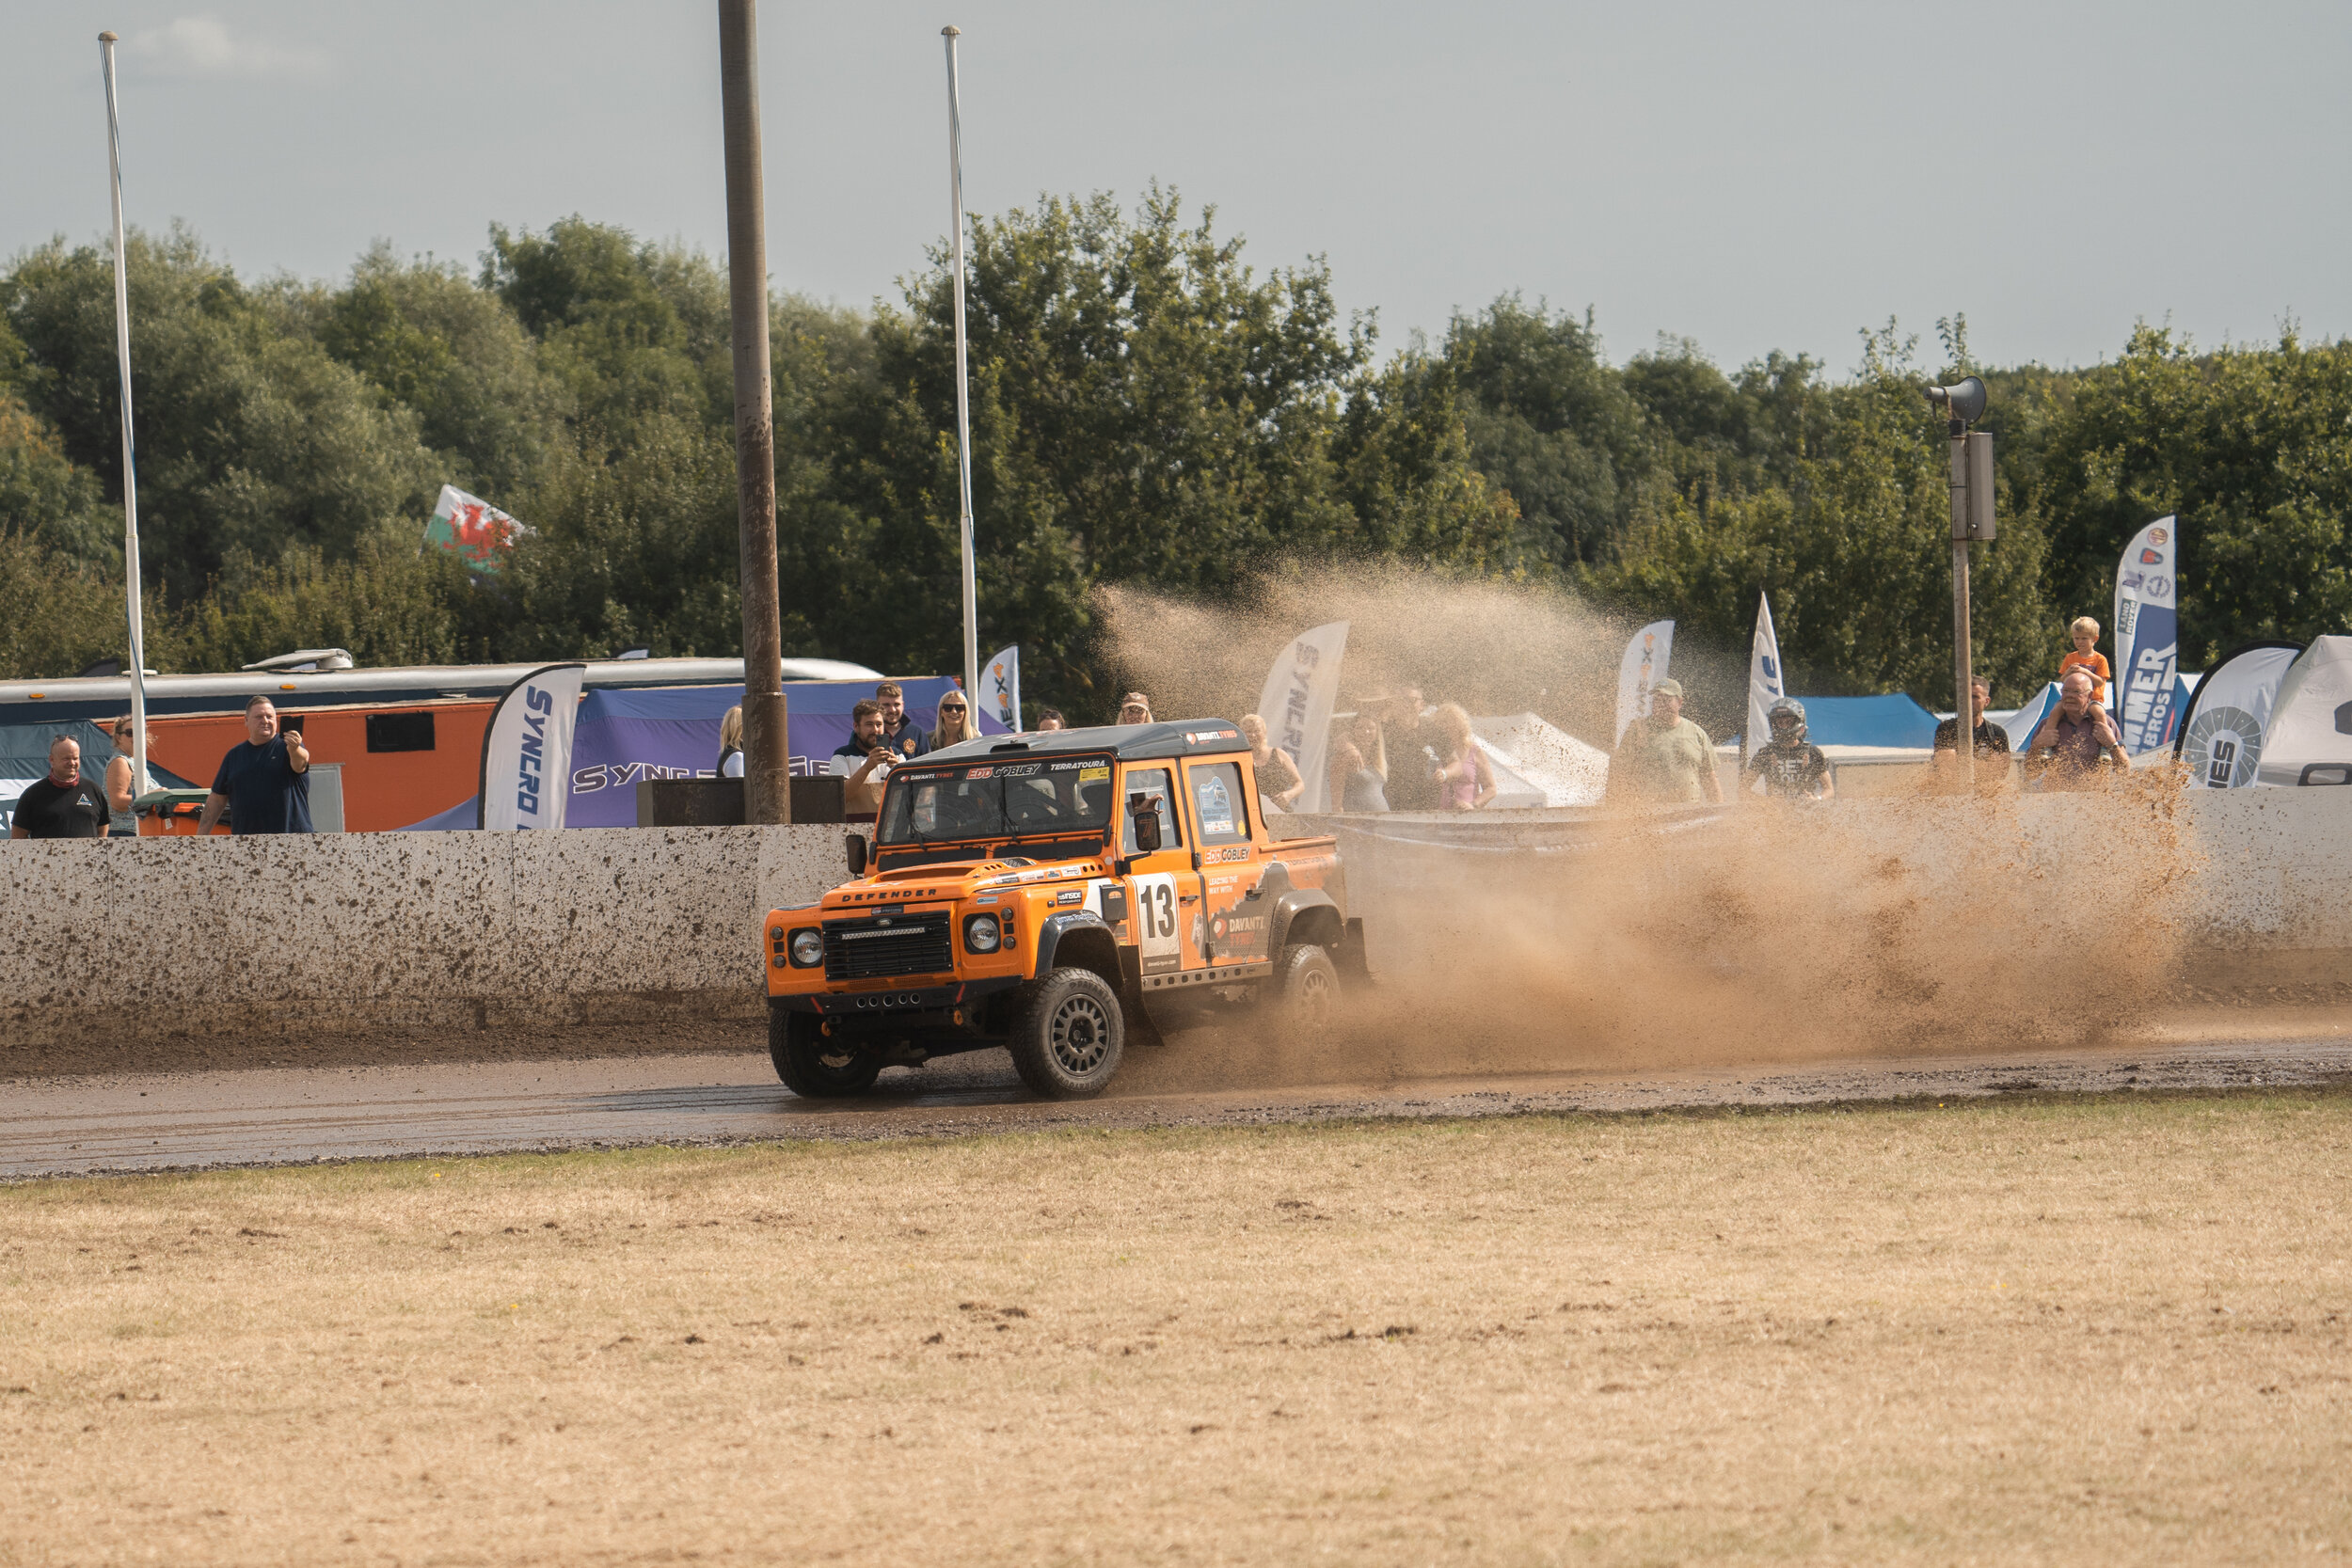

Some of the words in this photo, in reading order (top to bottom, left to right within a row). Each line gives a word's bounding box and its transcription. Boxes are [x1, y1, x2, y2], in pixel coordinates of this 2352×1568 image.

[2119, 602, 2130, 629] LAND
[2126, 600, 2137, 634] ROVER
[2123, 641, 2177, 756] MMER
[2143, 692, 2171, 748] BROS
[517, 685, 553, 816] SYNCRO
[966, 766, 994, 780] EDD
[993, 763, 1041, 778] COBLEY
[1204, 848, 1222, 864] EDD
[1221, 847, 1250, 862] COBLEY
[1209, 877, 1229, 886] LEADING
[1229, 875, 1239, 883] THE
[1220, 885, 1233, 894] WITH
[842, 888, 937, 903] DEFENDER
[1140, 883, 1175, 939] 13
[1229, 916, 1264, 932] DAVANTI
